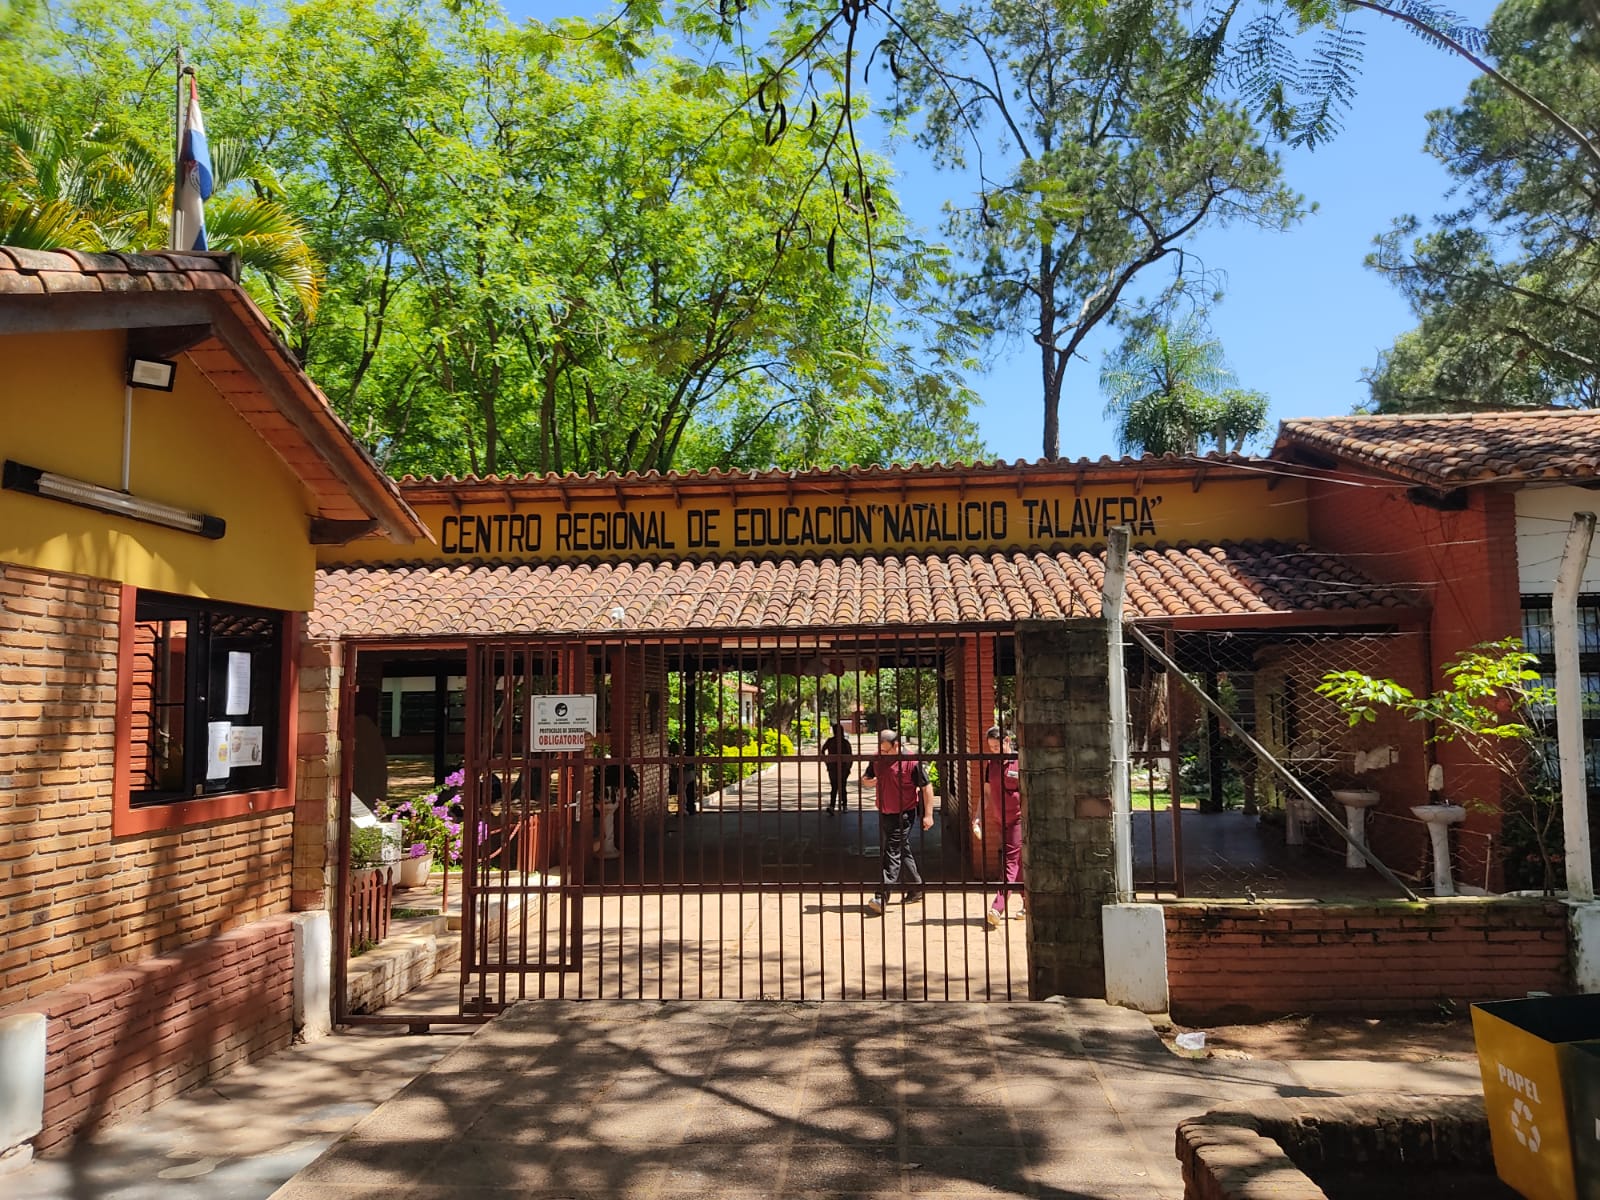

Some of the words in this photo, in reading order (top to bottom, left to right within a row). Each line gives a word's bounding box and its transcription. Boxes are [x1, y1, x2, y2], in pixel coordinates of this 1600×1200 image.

[442, 514, 541, 553] CENTRO
[556, 511, 675, 550] REGIONAL
[687, 509, 721, 548] DE
[734, 506, 873, 547] EDUCACION
[539, 735, 584, 745] OBLIGATORIO
[1498, 1063, 1542, 1104] PAPEL
